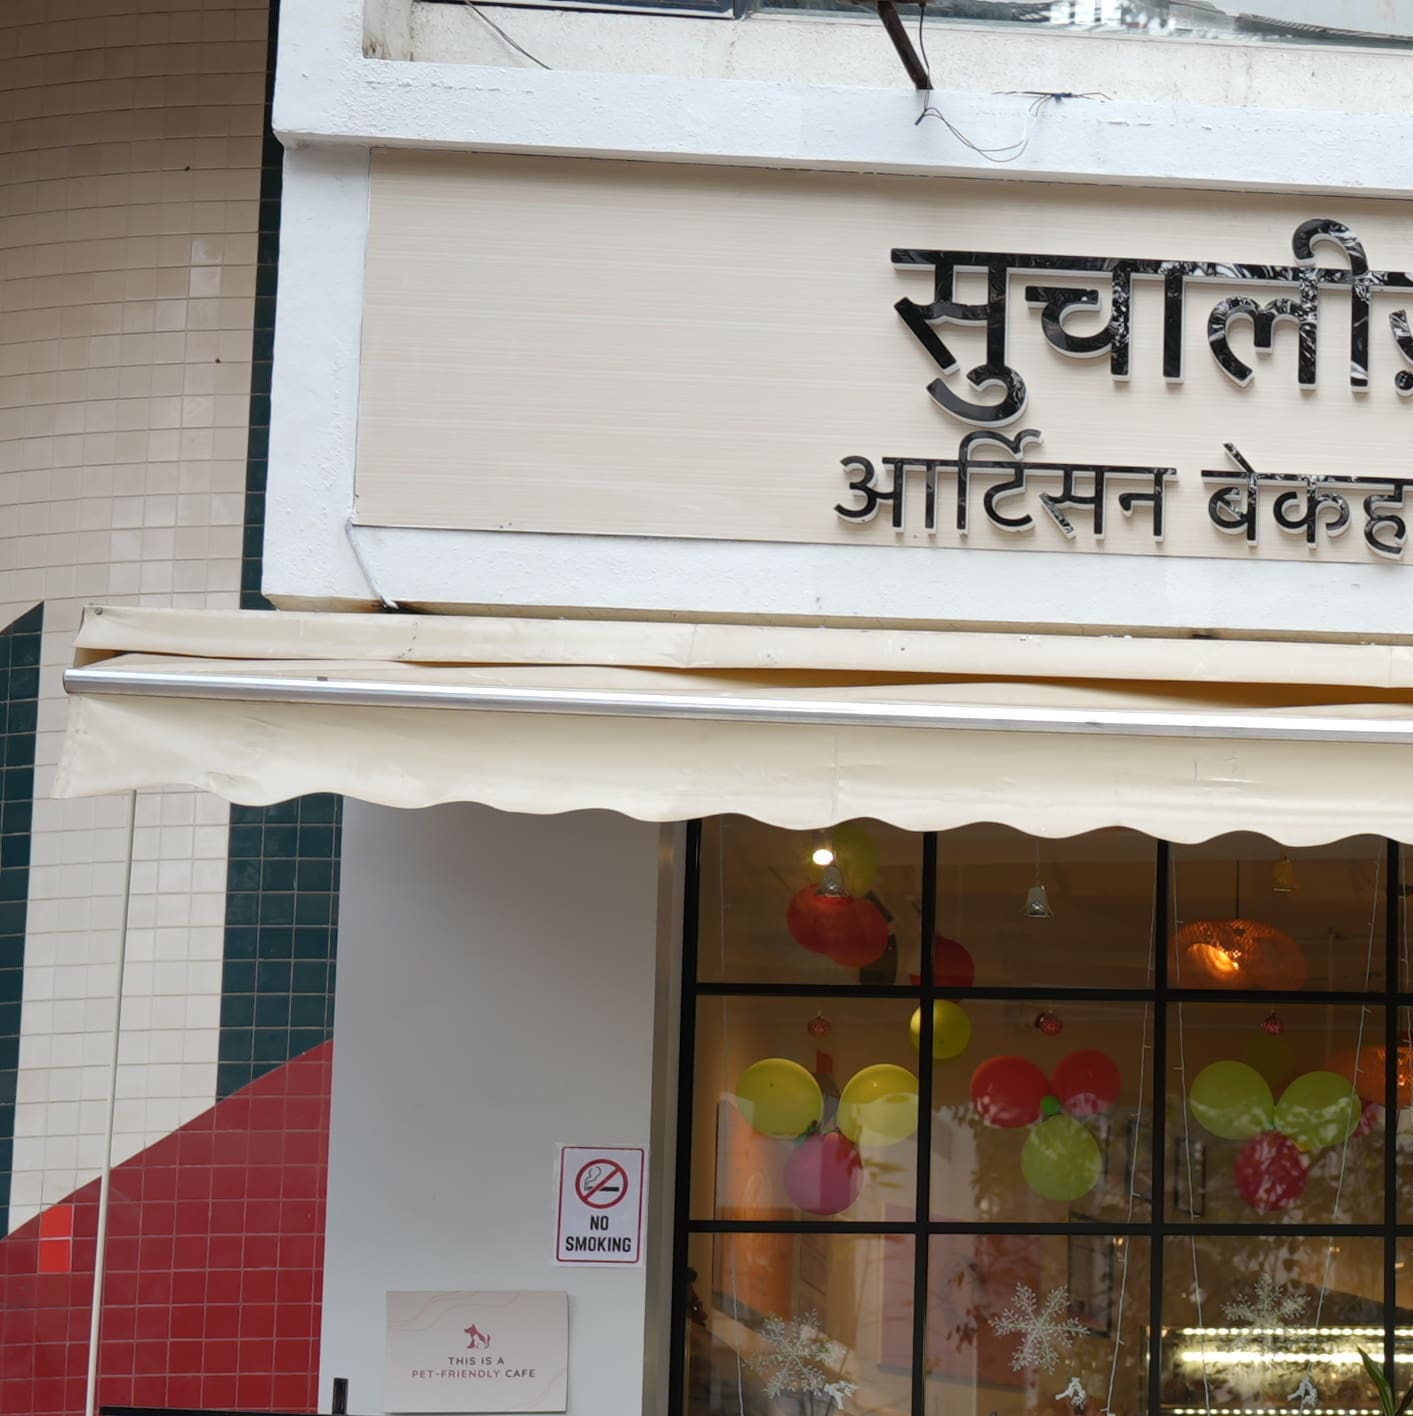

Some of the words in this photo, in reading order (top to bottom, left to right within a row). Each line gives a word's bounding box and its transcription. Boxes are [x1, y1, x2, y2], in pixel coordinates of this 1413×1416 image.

[589, 1215, 609, 1231] NO
[565, 1236, 632, 1253] SMOKING
[448, 1356, 477, 1366] THIS
[480, 1356, 493, 1366] IS
[496, 1356, 505, 1366] A
[411, 1369, 501, 1379] PET-FRIENDLY
[505, 1369, 536, 1379] CAFE
